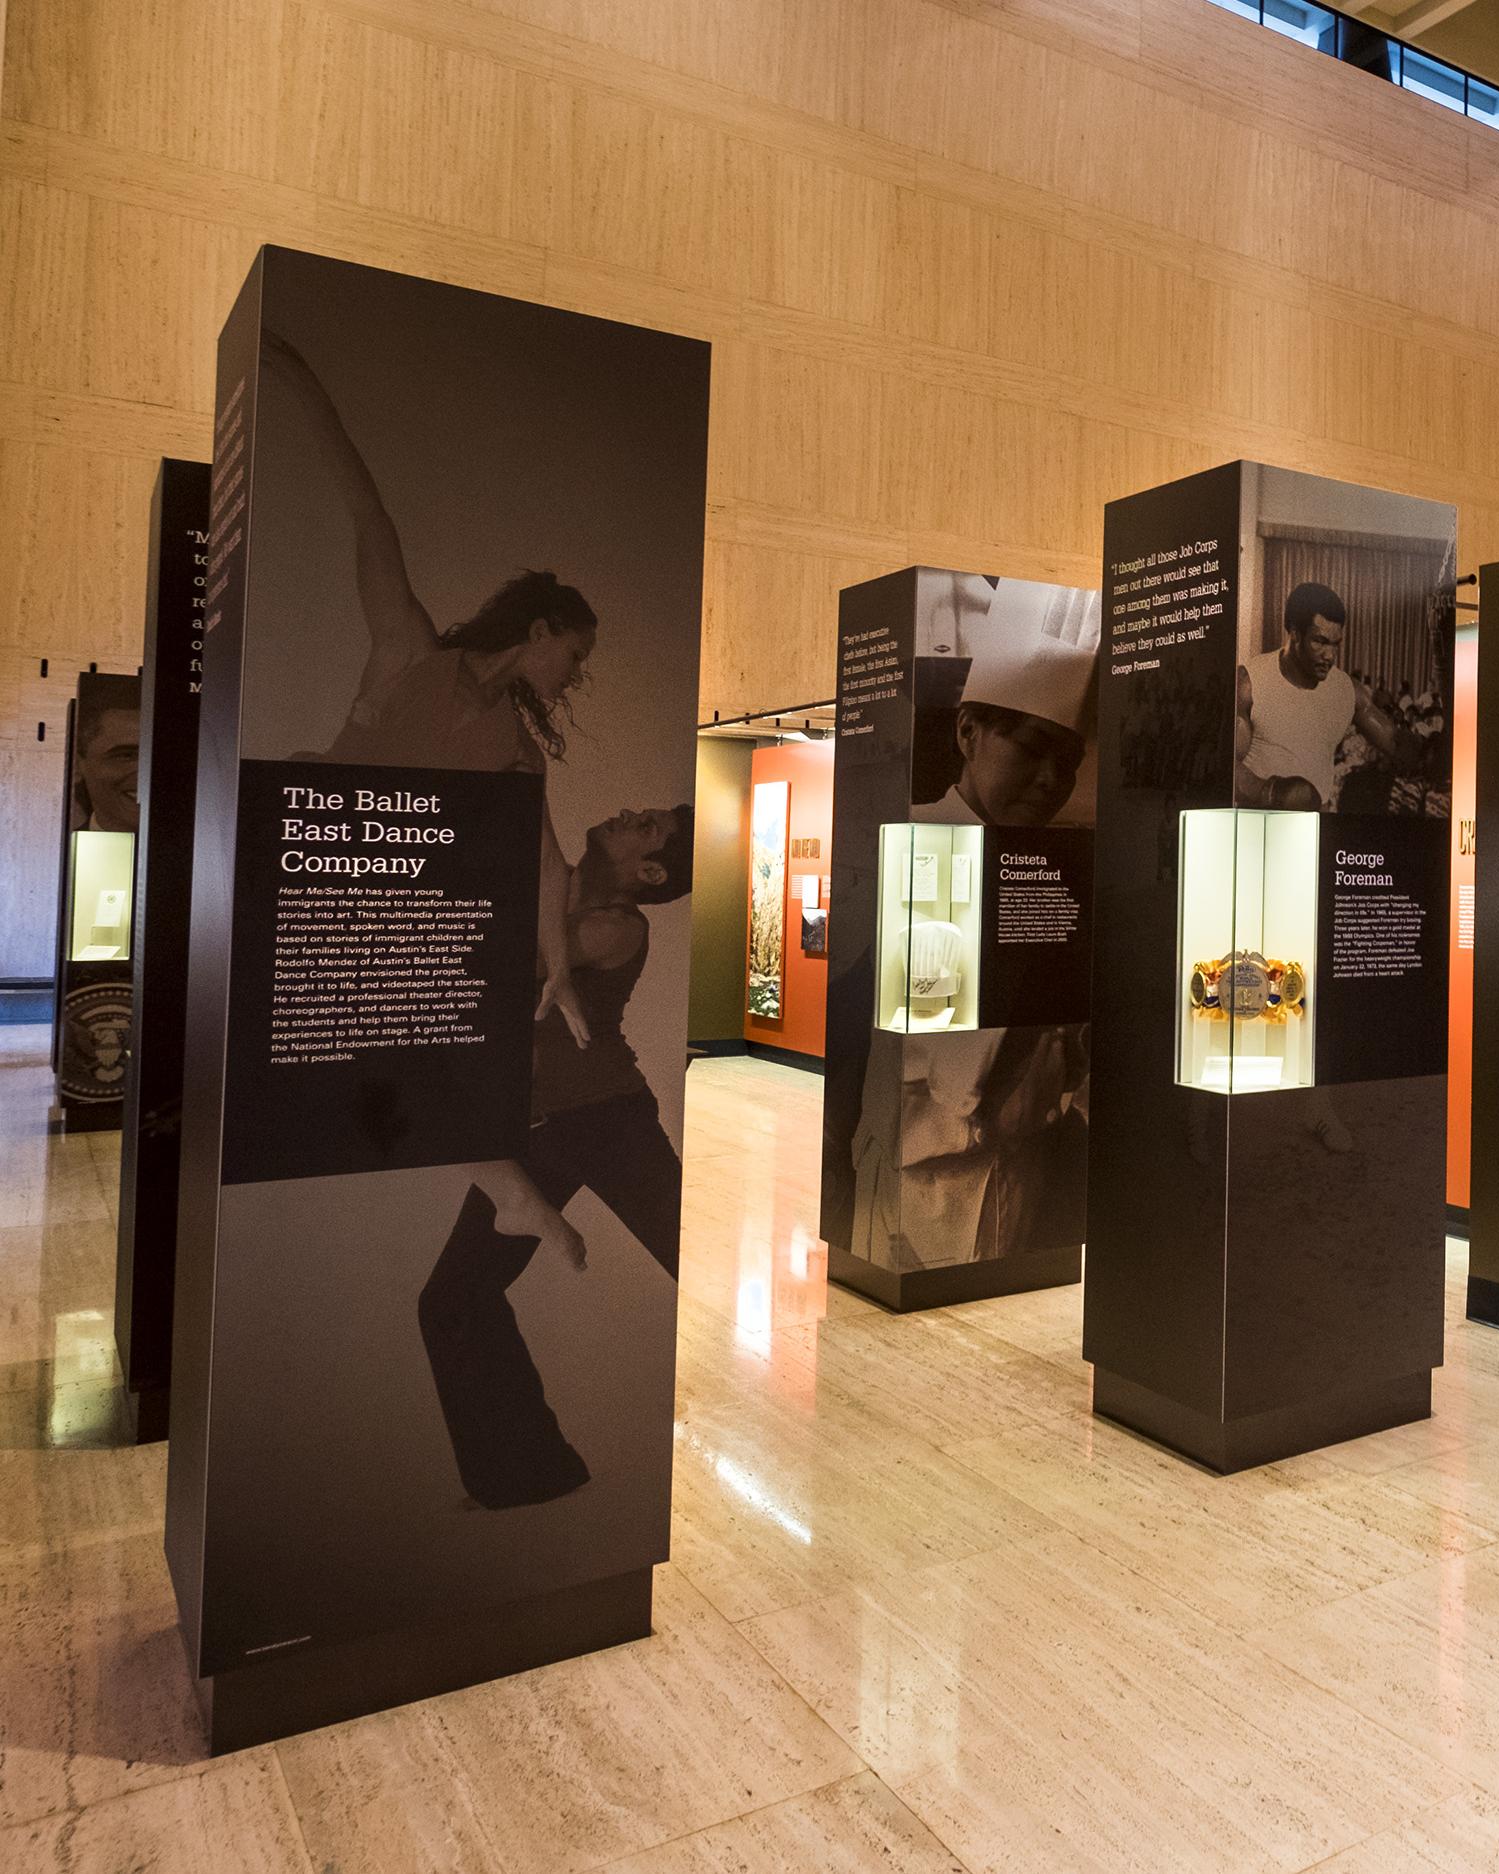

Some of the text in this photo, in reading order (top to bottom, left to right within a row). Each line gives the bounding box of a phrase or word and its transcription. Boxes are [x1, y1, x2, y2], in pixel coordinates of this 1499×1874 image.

[1119, 558, 1145, 574] thought
[1147, 554, 1156, 567] all
[1158, 551, 1178, 564] those
[1179, 546, 1193, 558] Job
[1195, 540, 1218, 554] Corps
[1114, 560, 1219, 595] men out there would see that
[1114, 605, 1126, 615] one
[1127, 599, 1150, 612] among
[1152, 594, 1171, 606] them
[1173, 590, 1188, 601] was
[1190, 583, 1219, 598] making
[1113, 604, 1223, 635] and maybe it would help them
[1113, 642, 1136, 655] believe
[1138, 638, 1154, 651] they
[1155, 632, 1175, 647] could
[1177, 633, 1186, 643] as
[1112, 660, 1160, 675] George Foreman
[283, 787, 440, 813] The Ballet
[280, 818, 454, 844] East Dance
[281, 850, 426, 878] Company
[1000, 853, 1047, 865] Cristeta
[1335, 849, 1384, 868] George
[999, 868, 1061, 881] Comerford
[1334, 870, 1393, 886] Foreman
[278, 887, 444, 897] Hear Me/See Me has given young
[277, 899, 335, 909] immigrants
[356, 899, 391, 907] chance
[406, 899, 452, 907] transform
[478, 899, 492, 907] life
[270, 1052, 355, 1063] make it possible.
